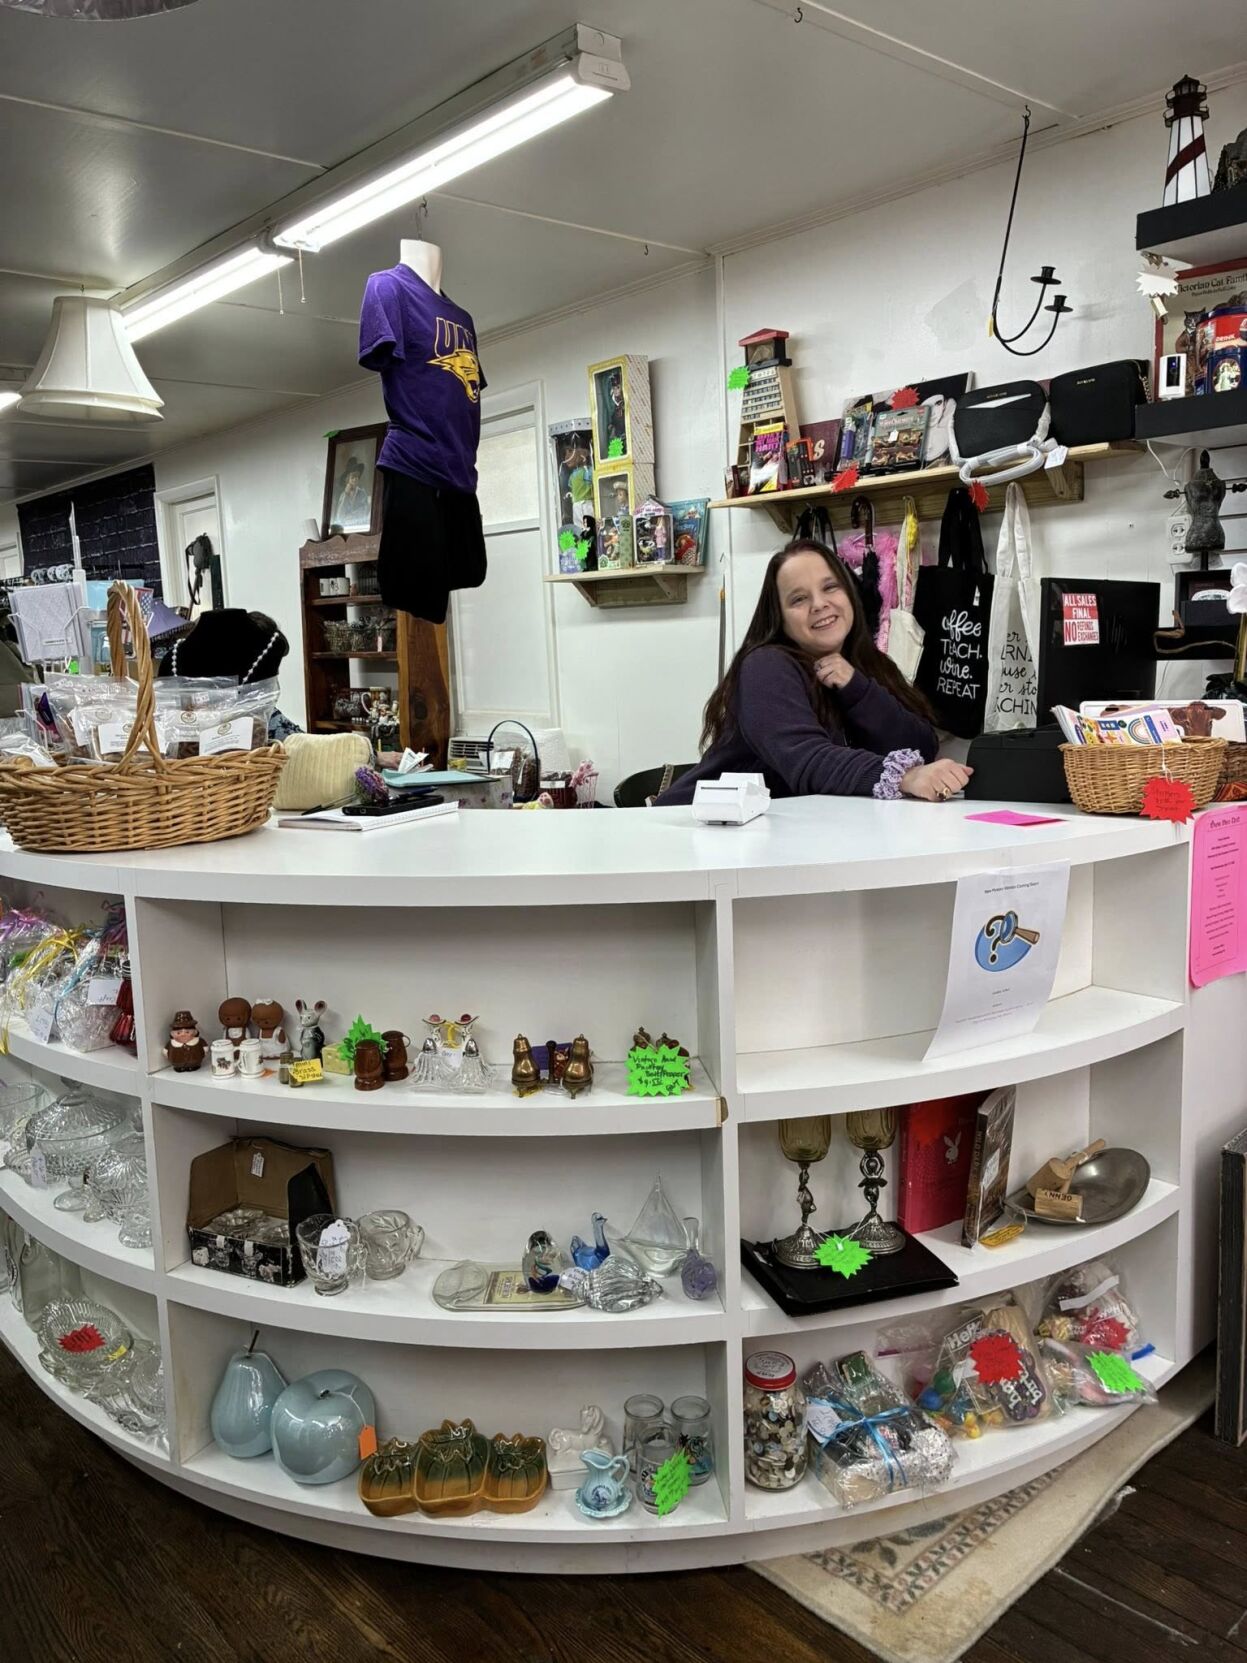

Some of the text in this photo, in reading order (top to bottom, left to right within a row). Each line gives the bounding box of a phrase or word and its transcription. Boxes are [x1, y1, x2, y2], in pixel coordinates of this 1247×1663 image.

[1064, 595, 1096, 606] ALL SALES
[1072, 607, 1091, 618] FINAL
[1065, 621, 1077, 642] NO
[936, 676, 980, 700] REPEAT
